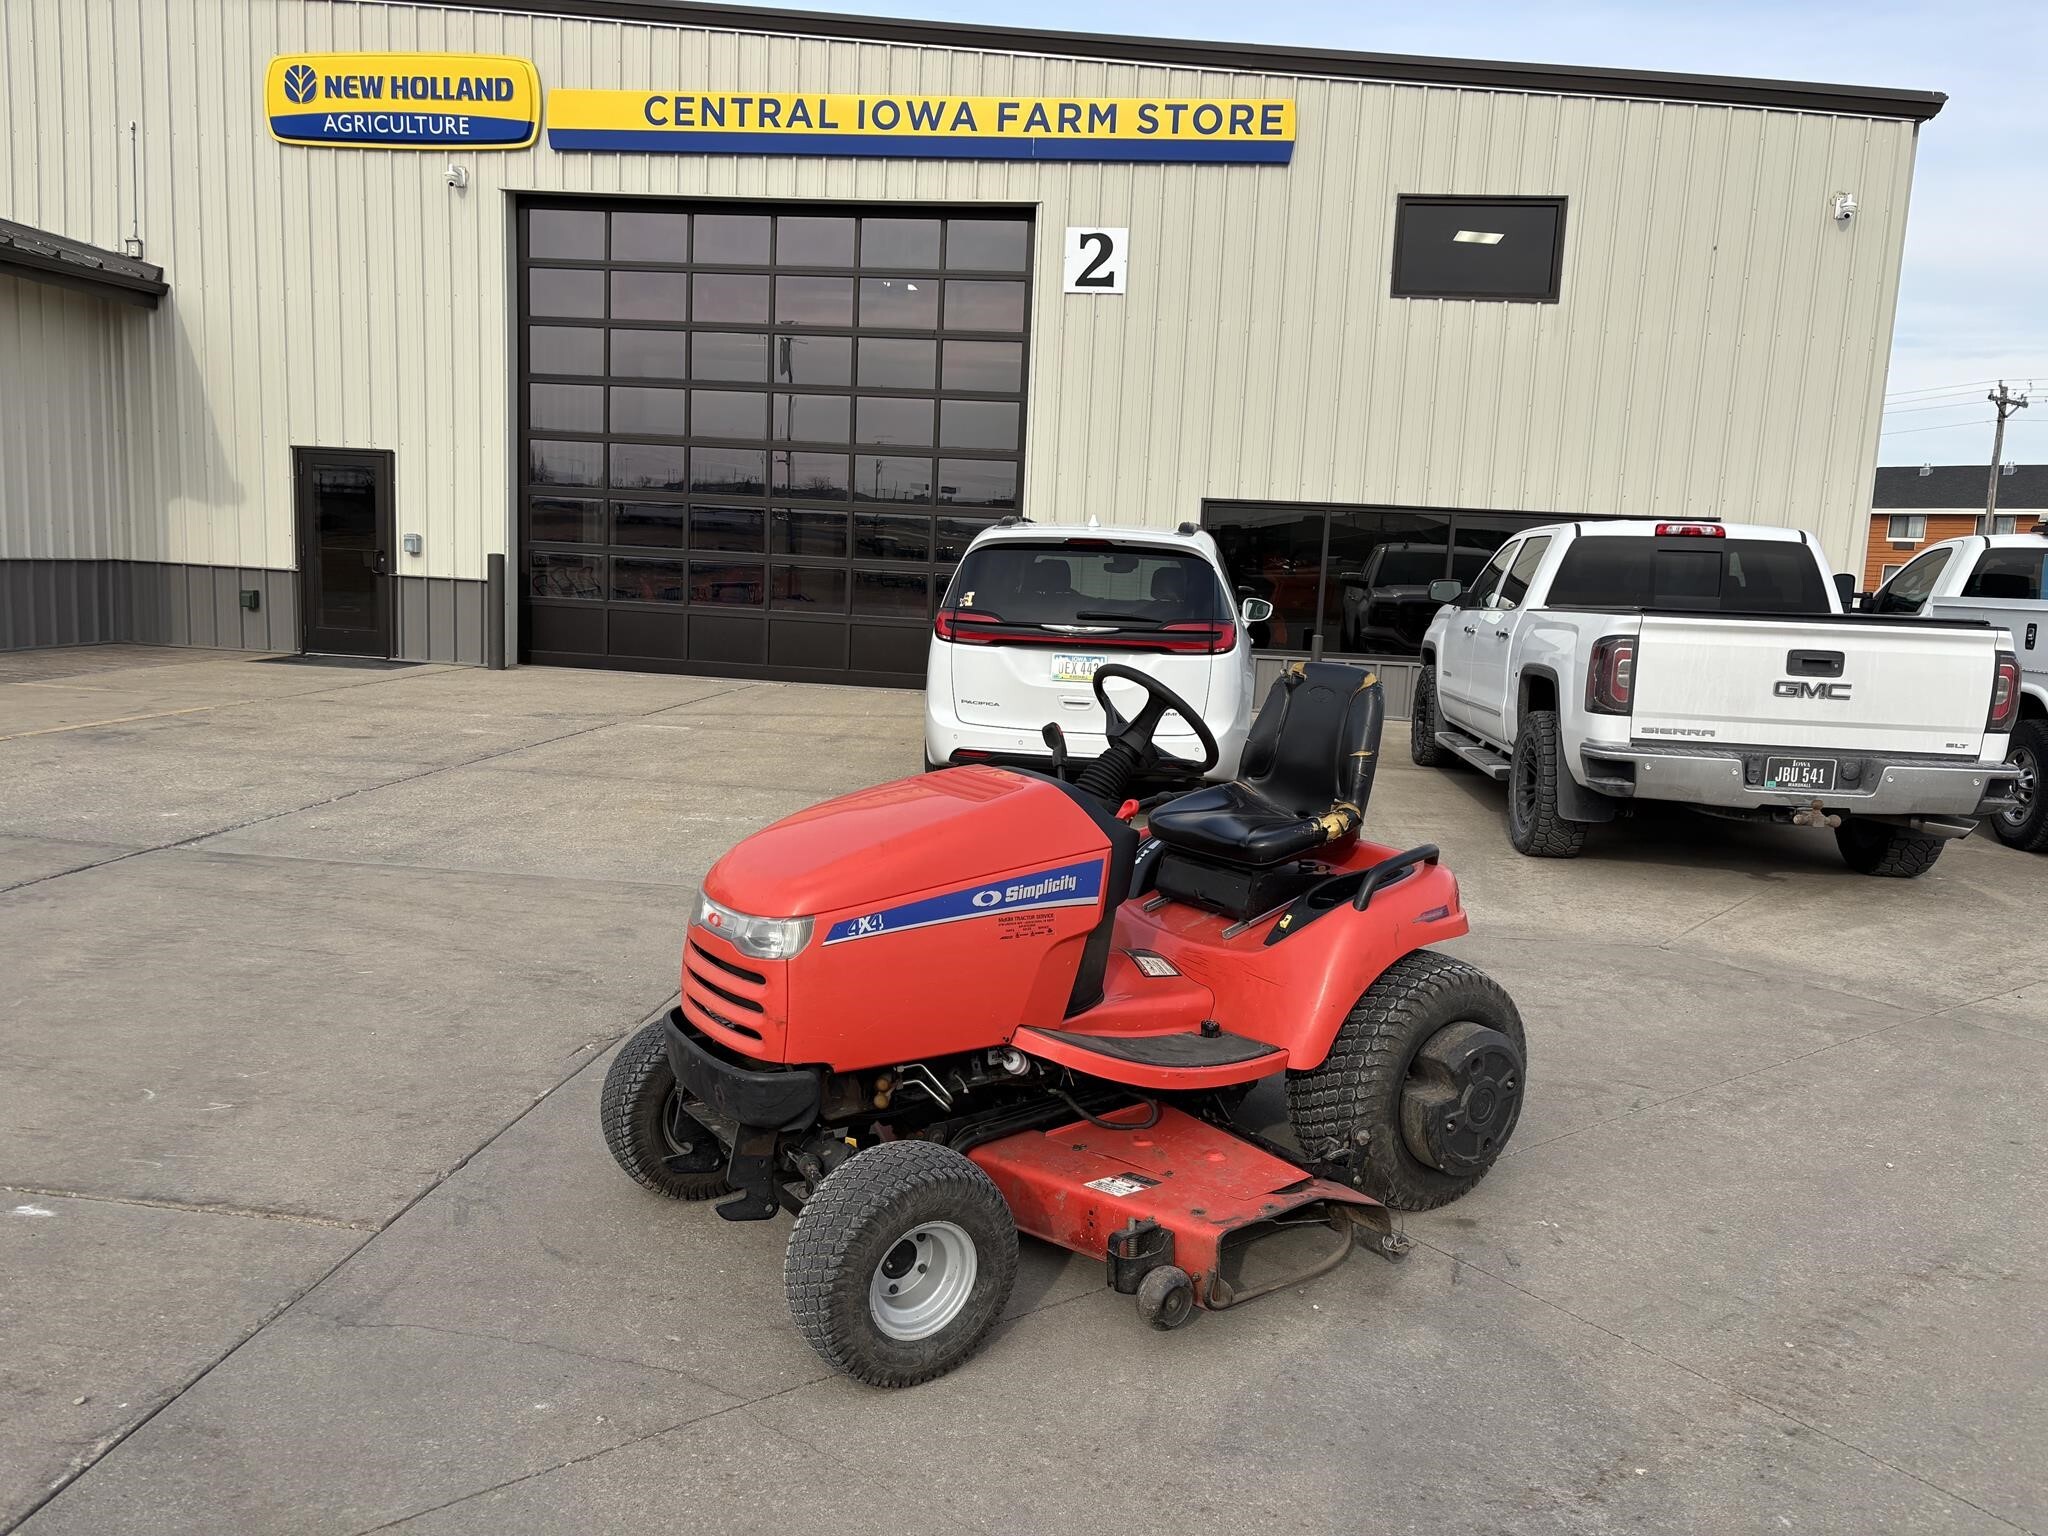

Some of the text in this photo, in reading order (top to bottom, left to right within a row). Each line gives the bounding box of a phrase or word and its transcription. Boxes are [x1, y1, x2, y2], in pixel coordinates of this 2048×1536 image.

[324, 75, 515, 102] NEW HOLLAND
[323, 114, 471, 136] AGRICULTURE
[643, 95, 1285, 136] CENTRAL IOWA FARM STORE
[1075, 232, 1115, 288] 2
[1773, 681, 1852, 701] GMC
[960, 699, 1001, 707] PACIFICA
[1641, 727, 1716, 737] SIERRA
[1775, 767, 1825, 784] JBU 541
[1004, 874, 1078, 903] Simplicity
